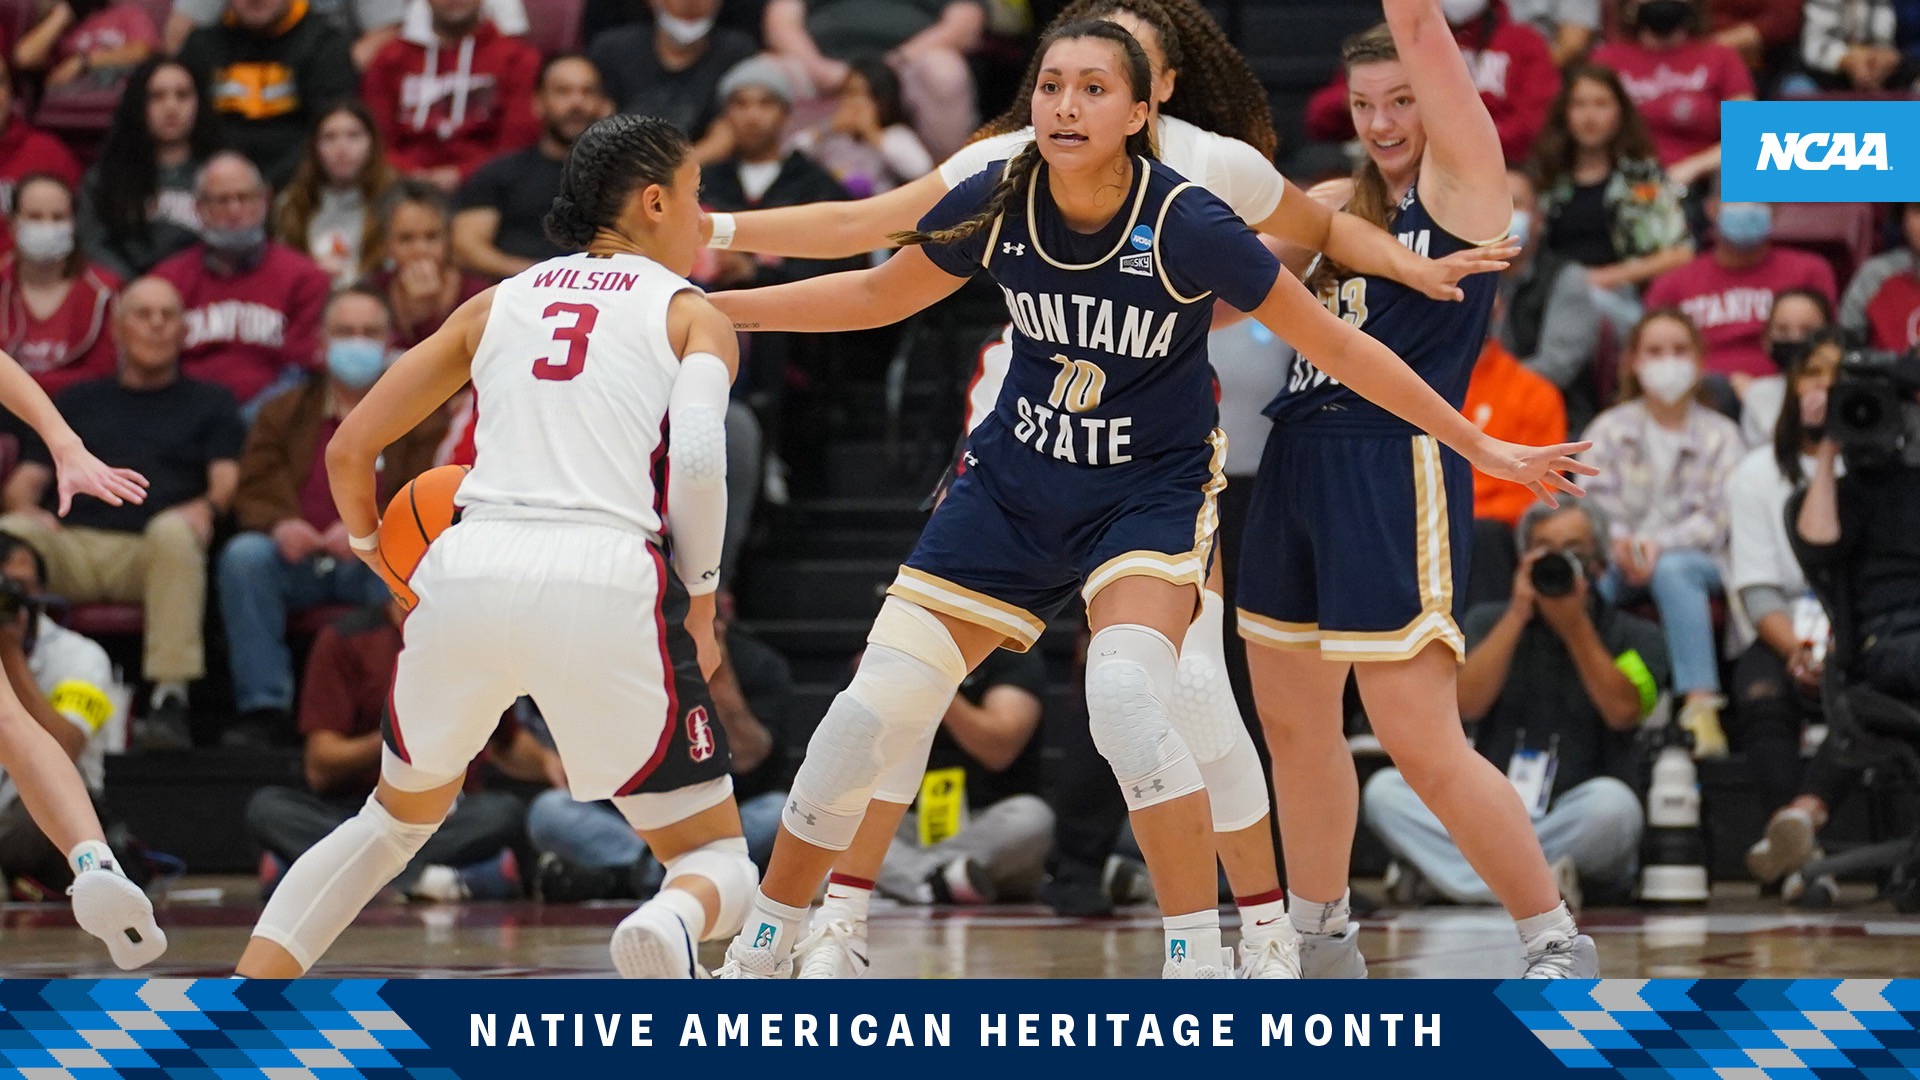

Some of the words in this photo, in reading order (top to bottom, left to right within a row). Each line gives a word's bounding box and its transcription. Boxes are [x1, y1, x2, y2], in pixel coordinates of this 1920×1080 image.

[533, 268, 639, 291] WILSON
[532, 302, 599, 381] 3
[1048, 353, 1106, 413] 10
[1014, 396, 1132, 465] STATE
